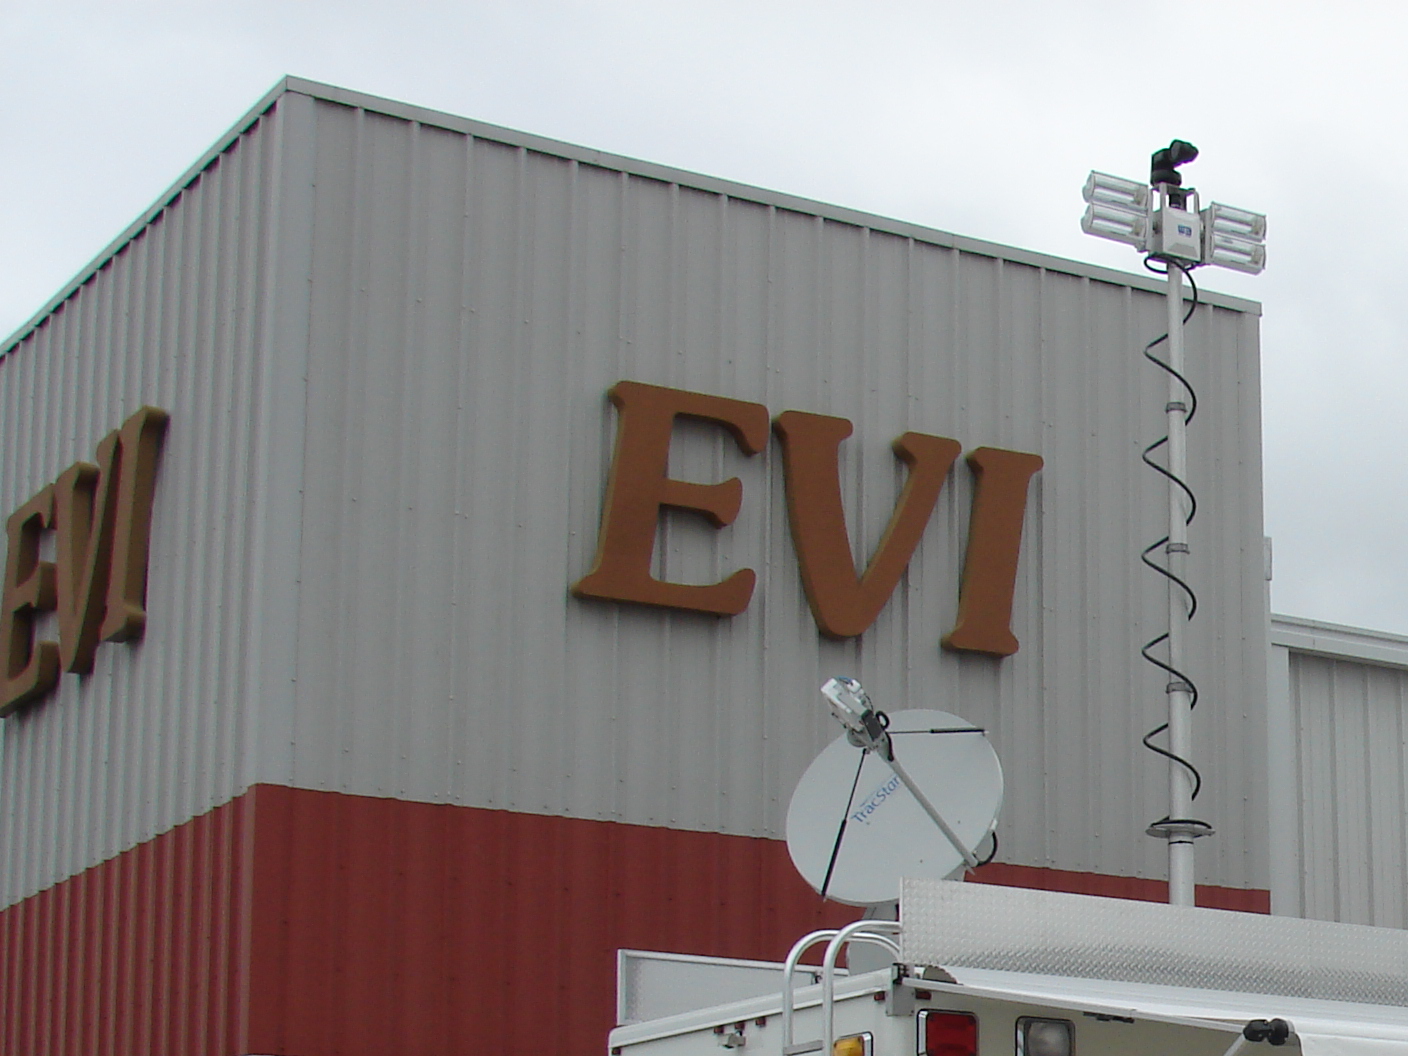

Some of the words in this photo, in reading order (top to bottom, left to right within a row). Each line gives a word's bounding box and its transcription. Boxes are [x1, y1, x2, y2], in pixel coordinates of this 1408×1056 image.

[0, 405, 170, 718] EVI
[571, 380, 1044, 657] EVI
[850, 776, 899, 823] TracStar
